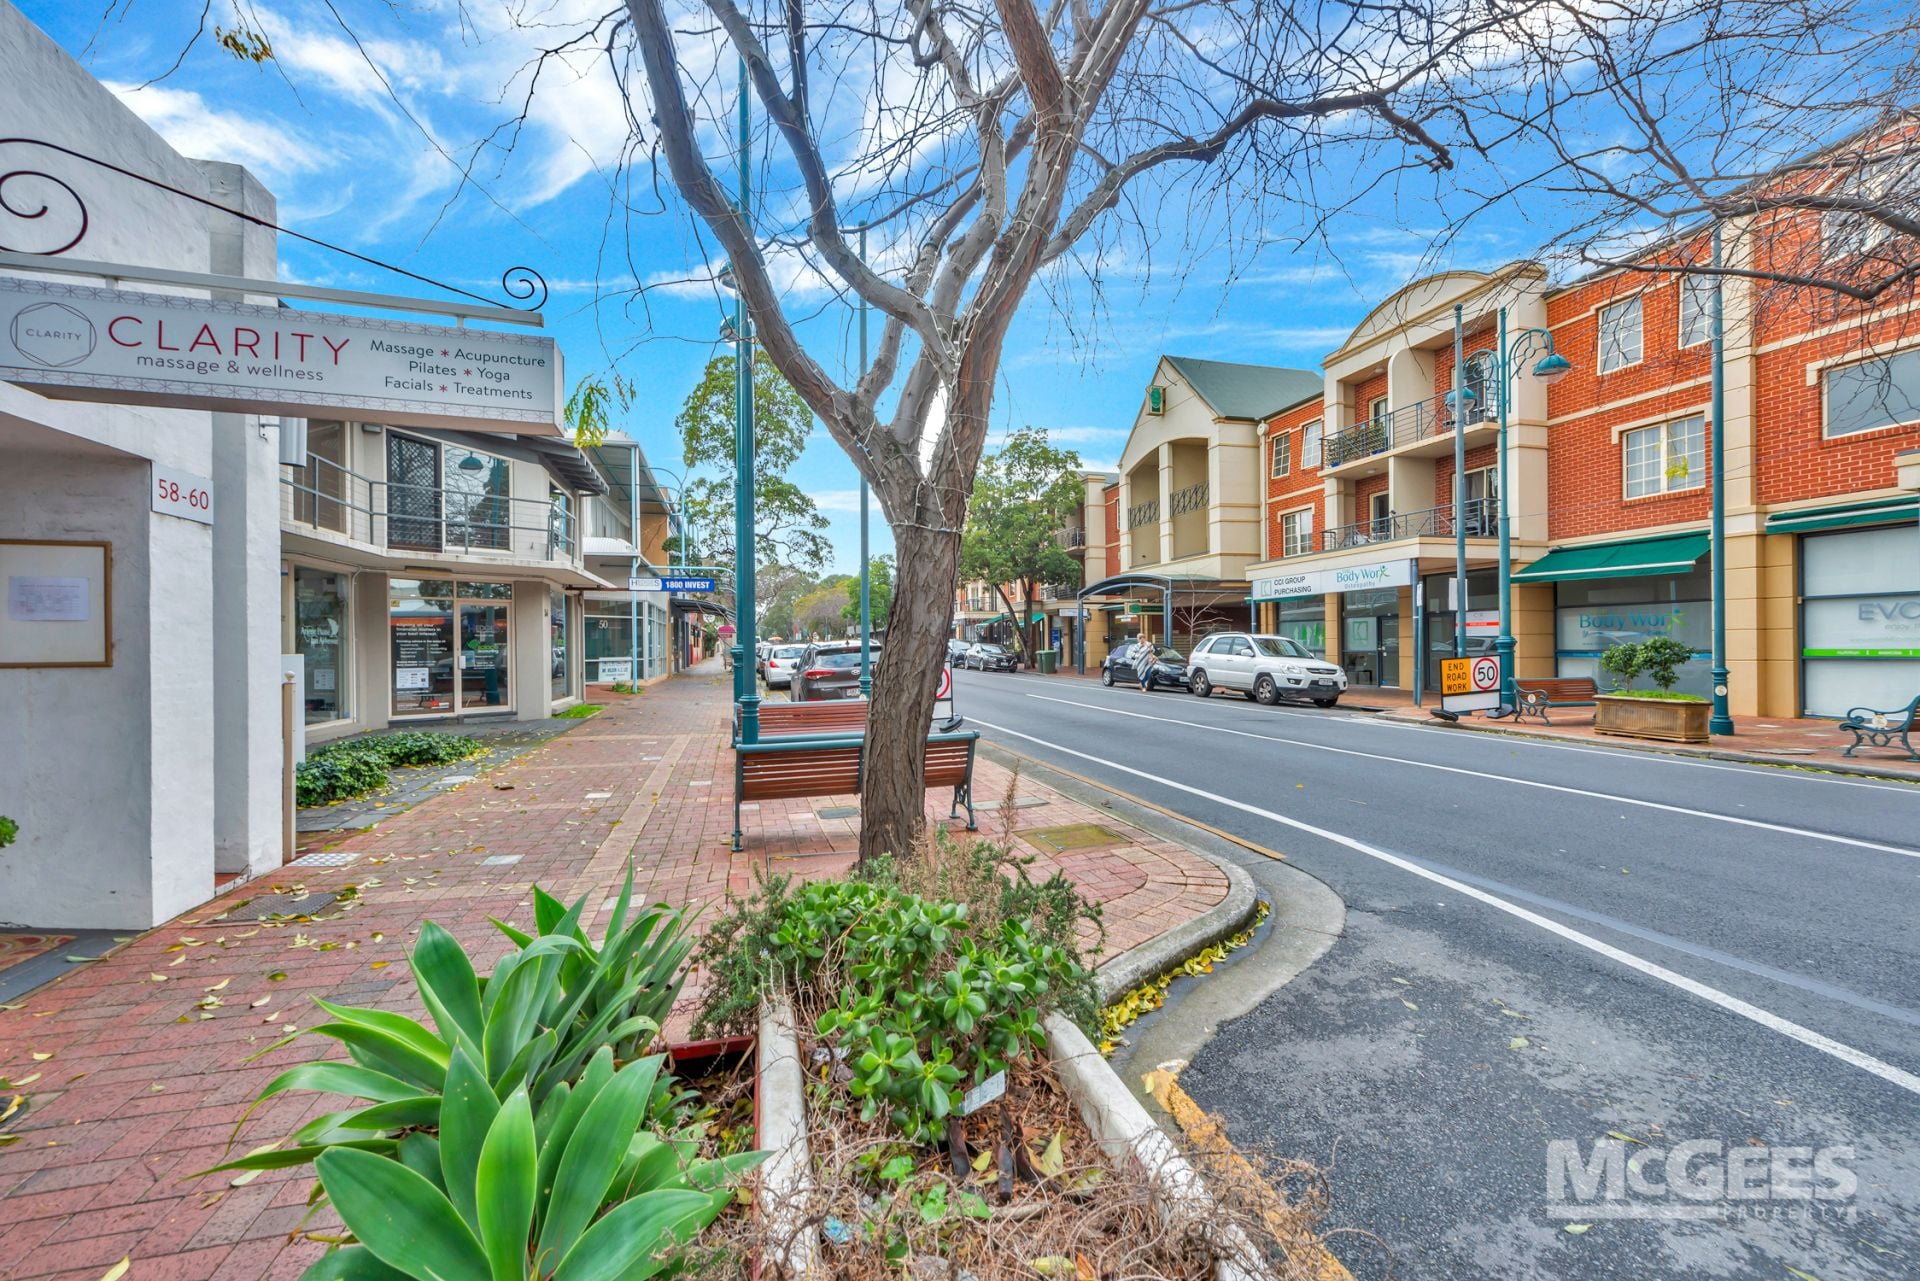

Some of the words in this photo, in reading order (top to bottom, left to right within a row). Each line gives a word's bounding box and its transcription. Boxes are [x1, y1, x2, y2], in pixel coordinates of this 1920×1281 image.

[26, 328, 82, 341] CLARITY
[108, 316, 350, 365] CLARITY
[370, 339, 434, 358] Massage
[454, 348, 546, 368] Acupuncture
[137, 354, 220, 374] massage
[227, 359, 240, 373] &
[247, 362, 324, 382] wellness
[409, 360, 457, 377] Pilates
[476, 367, 511, 383] Yoga
[385, 376, 434, 392] Facials
[453, 382, 533, 400] Treatments
[158, 478, 209, 510] 58-60
[1285, 576, 1306, 584] GROUP
[1336, 569, 1360, 583] Body
[665, 580, 683, 589] 1800
[684, 581, 710, 589] INVEST
[1274, 585, 1312, 595] PURCHASING
[598, 619, 609, 629] 50
[1580, 611, 1625, 630] Body
[1447, 662, 1465, 671] END
[1477, 665, 1496, 682] 50
[1446, 672, 1467, 682] ROAD
[1446, 683, 1467, 692] WORK
